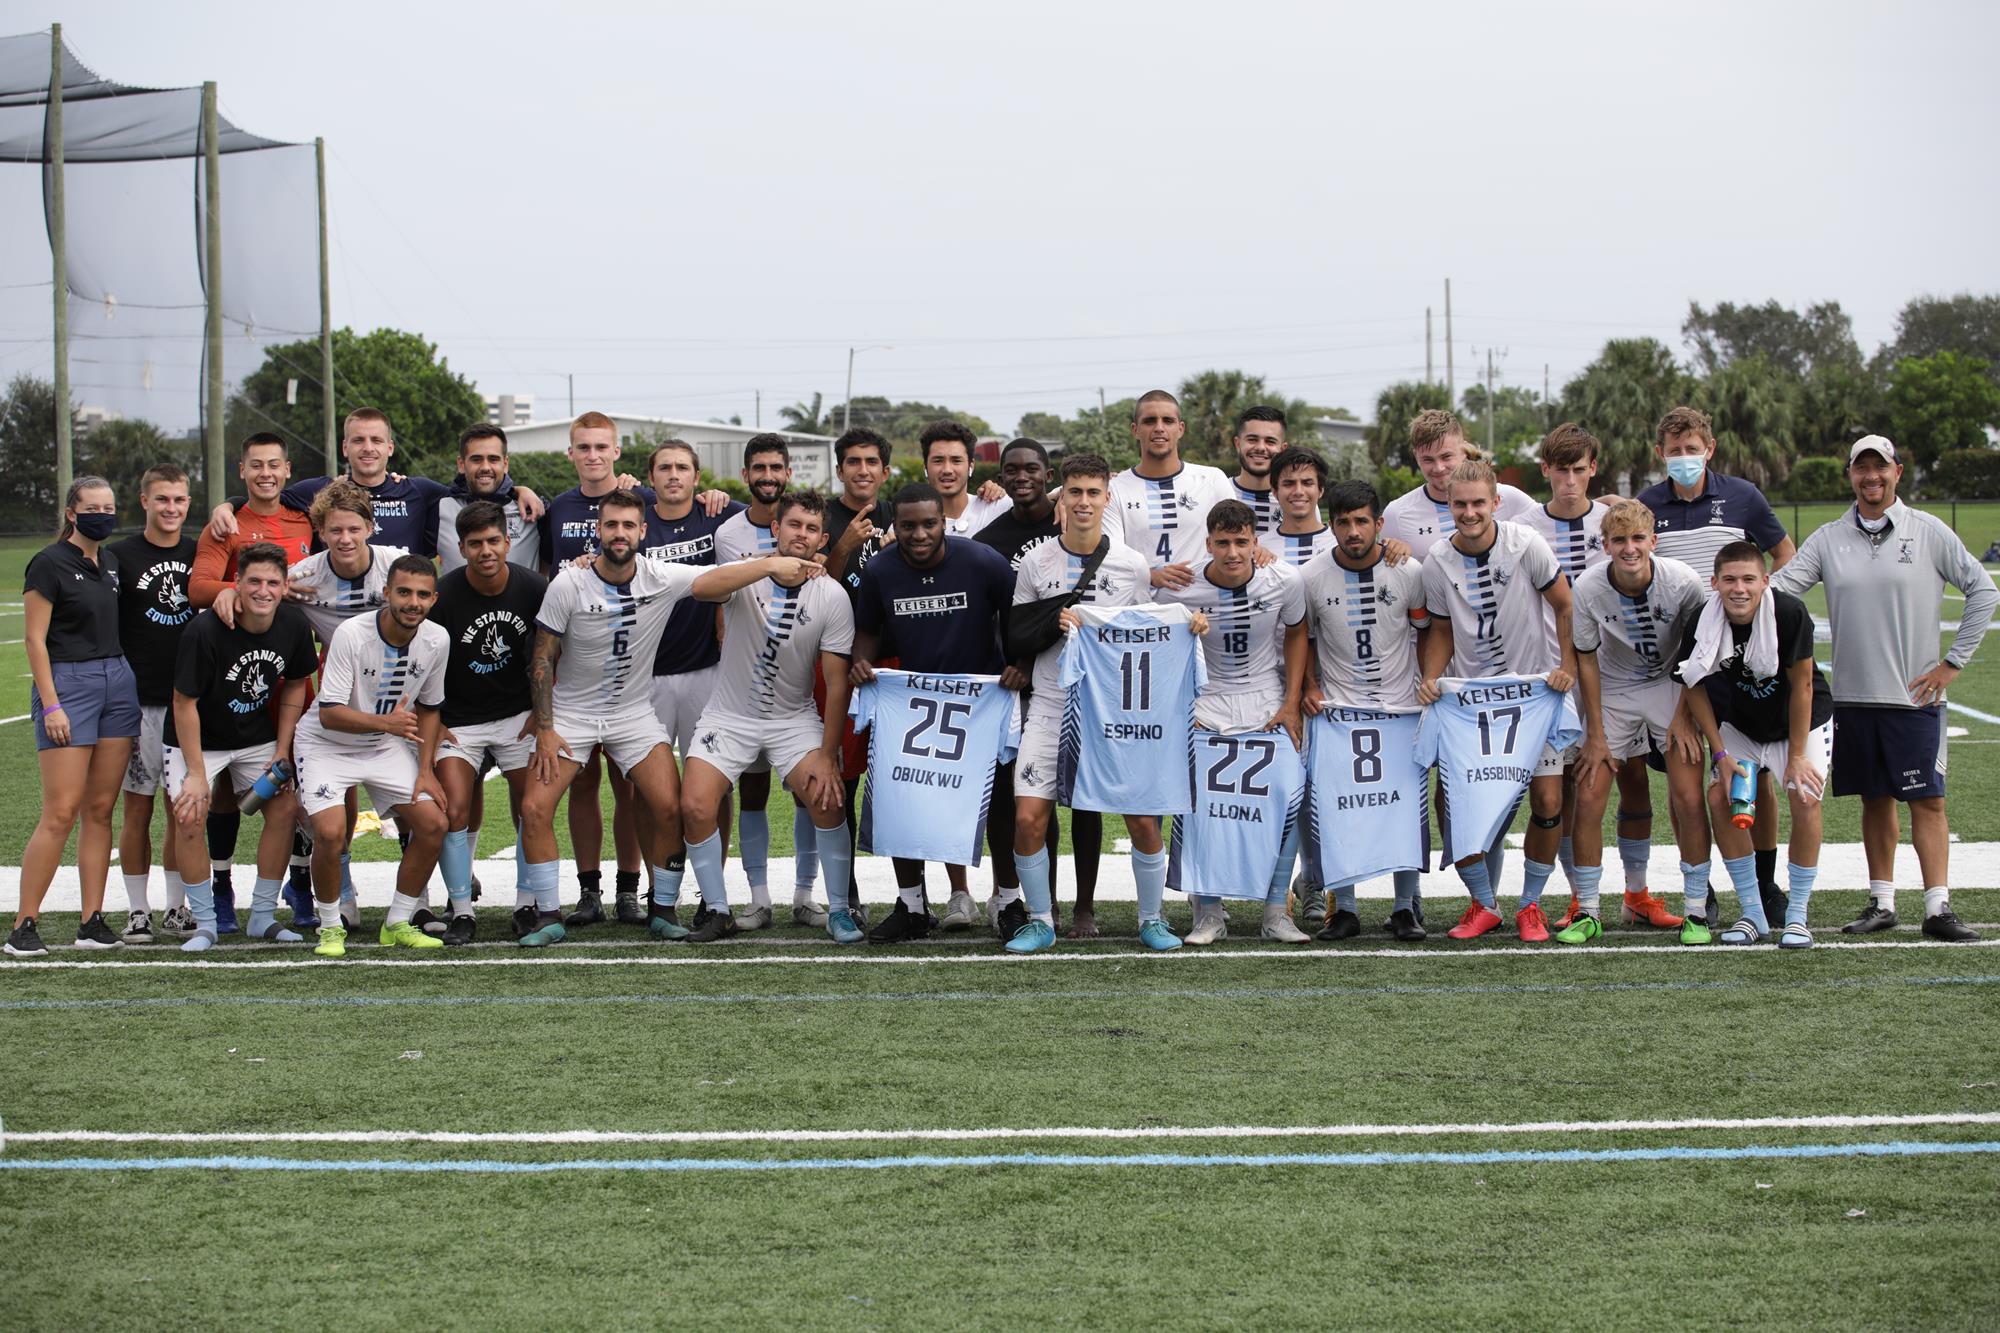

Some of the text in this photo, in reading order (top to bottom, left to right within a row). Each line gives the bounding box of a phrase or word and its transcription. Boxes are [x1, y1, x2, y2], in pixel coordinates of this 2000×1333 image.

[373, 500, 409, 517] SOCCER
[561, 522, 588, 538] MEN'S
[647, 541, 697, 560] KEISER
[1156, 533, 1172, 563] 4
[136, 572, 154, 590] WE
[149, 561, 187, 576] STAND
[145, 607, 193, 626] EQUALITY
[895, 599, 946, 611] KEISER
[460, 610, 527, 644] WE STAND FOR
[1097, 625, 1171, 644] KEISER
[1477, 609, 1498, 640] 17
[612, 629, 629, 657] 6
[761, 635, 780, 662] 5
[1222, 631, 1248, 654] 18
[1356, 628, 1372, 659] 8
[225, 662, 241, 681] WE
[240, 649, 276, 666] STAND
[906, 673, 983, 697] KEISER
[1119, 649, 1152, 713] 11
[1456, 682, 1532, 707] KEISER
[901, 696, 972, 761] 25
[1104, 723, 1163, 740] ESPINO
[1477, 704, 1523, 757] 17
[1206, 735, 1278, 798] 22
[1351, 728, 1383, 784] 8
[1208, 802, 1263, 824] LLONA
[1337, 789, 1401, 811] RIVERA
